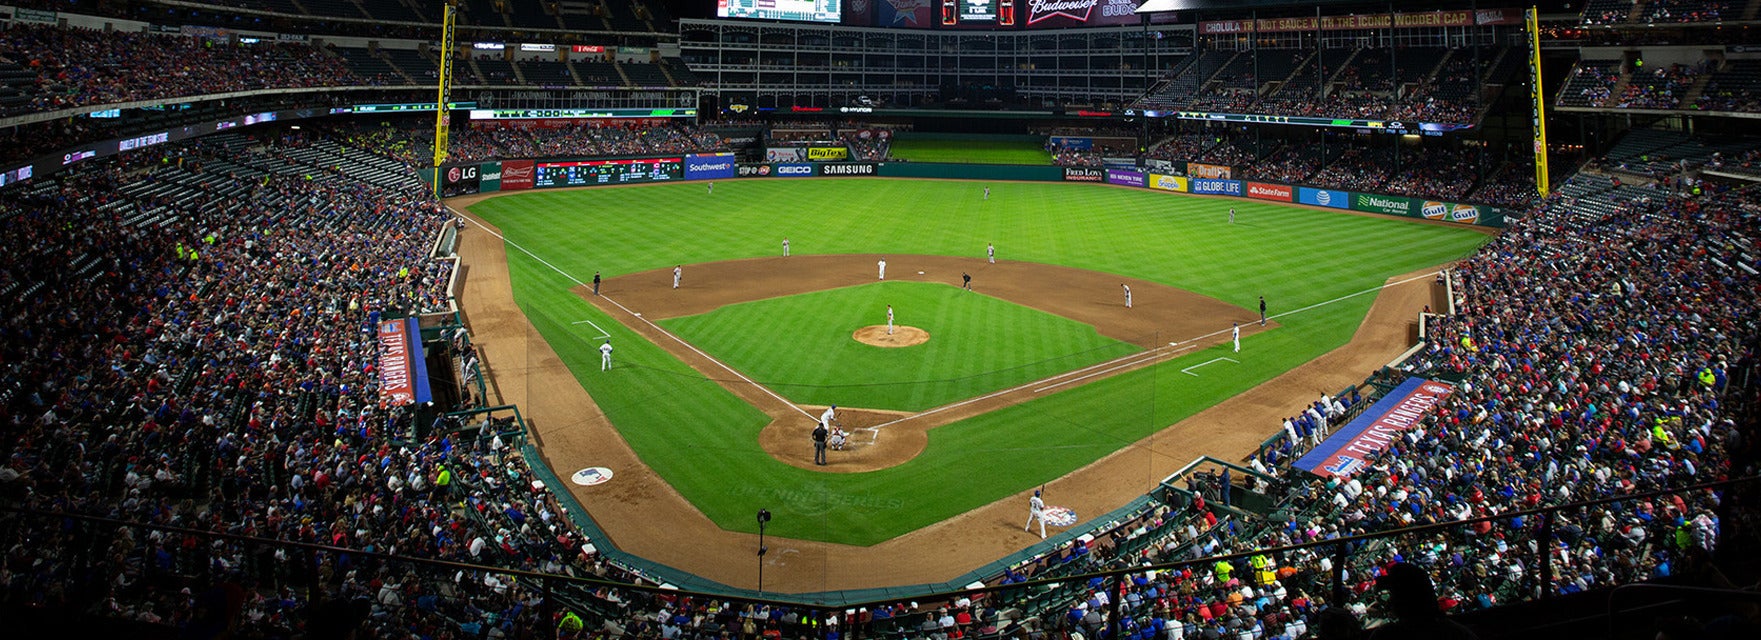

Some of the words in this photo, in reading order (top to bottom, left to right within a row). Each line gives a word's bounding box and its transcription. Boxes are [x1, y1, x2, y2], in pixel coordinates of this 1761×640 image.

[1028, 0, 1098, 13] Budweiser
[1103, 3, 1137, 17] BUDS
[1206, 22, 1241, 33] CHOLULA
[1243, 22, 1254, 32] TH
[1260, 20, 1276, 31] HOT
[1279, 18, 1308, 30] SAUCE
[1338, 15, 1355, 28] THE
[1358, 13, 1391, 27] ICONIC
[1394, 13, 1440, 26] WOODEN
[1444, 12, 1467, 25] CAP
[462, 167, 476, 180] LG
[689, 163, 726, 172] Southwest
[778, 166, 812, 174] GEICO
[824, 164, 873, 175] SAMSUNG
[1066, 168, 1084, 176] FRED
[1158, 179, 1180, 189] Snapple
[1202, 181, 1225, 192] GLOBE
[1225, 182, 1239, 194] LIFE
[1369, 197, 1409, 209] National
[1423, 206, 1446, 216] Gulf
[1453, 209, 1477, 219] Gulf
[382, 333, 404, 357] TEXAS
[382, 356, 408, 391] RANGERS
[1346, 425, 1397, 454] TEXAS
[1382, 392, 1435, 428] RANGERS
